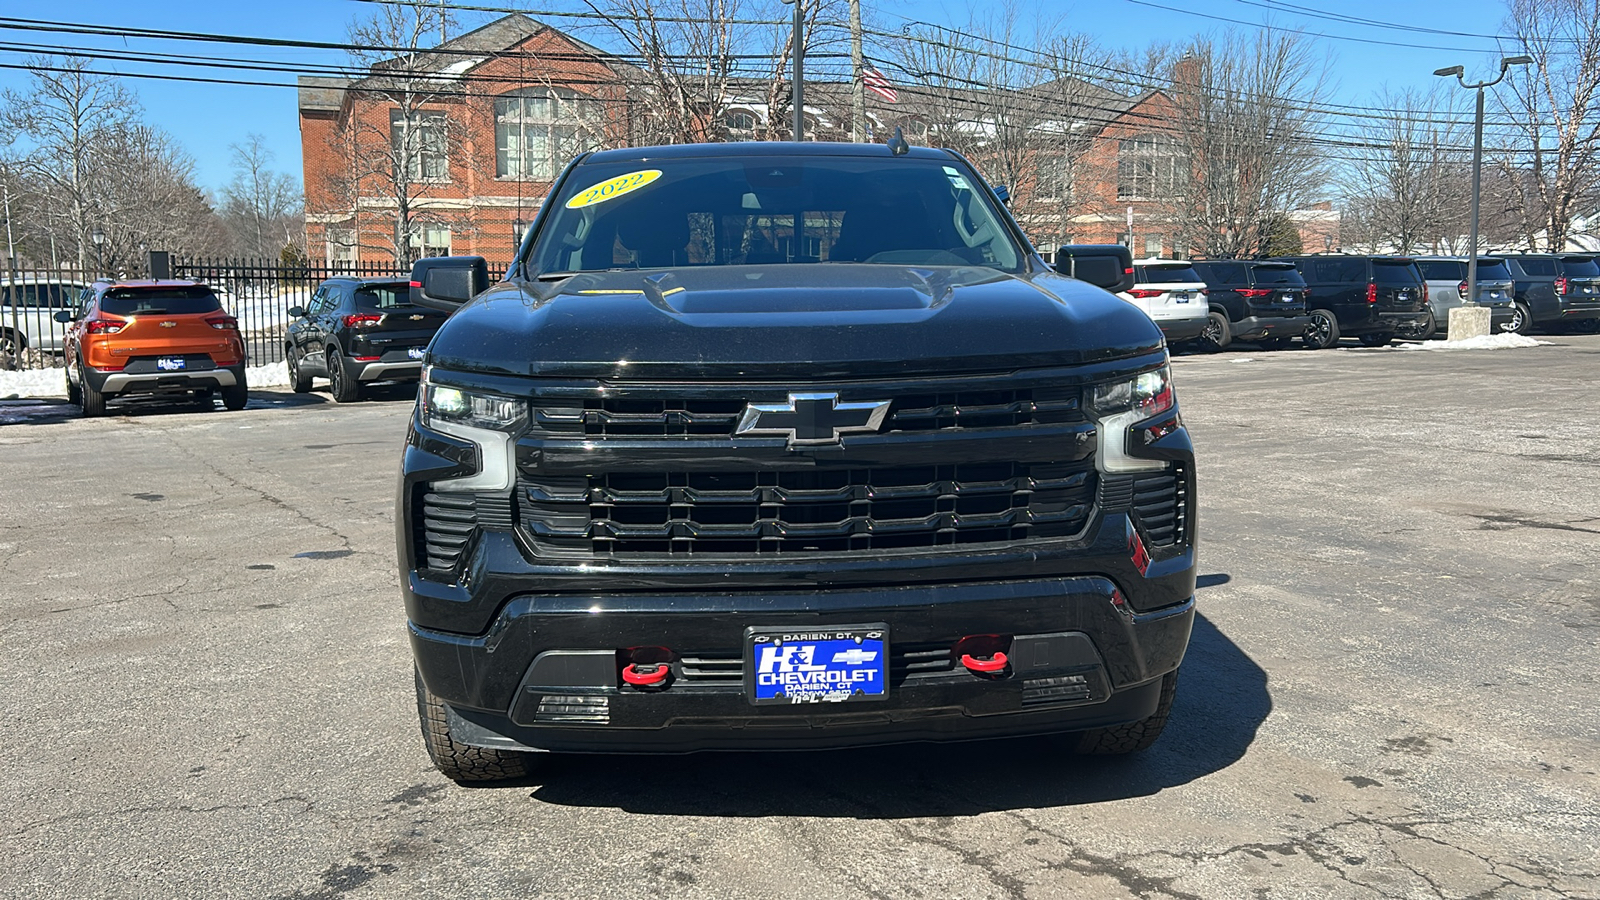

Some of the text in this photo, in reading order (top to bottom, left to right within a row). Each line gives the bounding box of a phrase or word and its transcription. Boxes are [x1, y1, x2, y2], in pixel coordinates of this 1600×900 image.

[586, 174, 645, 203] 2022
[783, 632, 854, 642] DARIEN, CT.
[758, 645, 827, 673] H&L
[758, 669, 878, 685] CHEVROLET
[785, 683, 832, 692] DARIEN,
